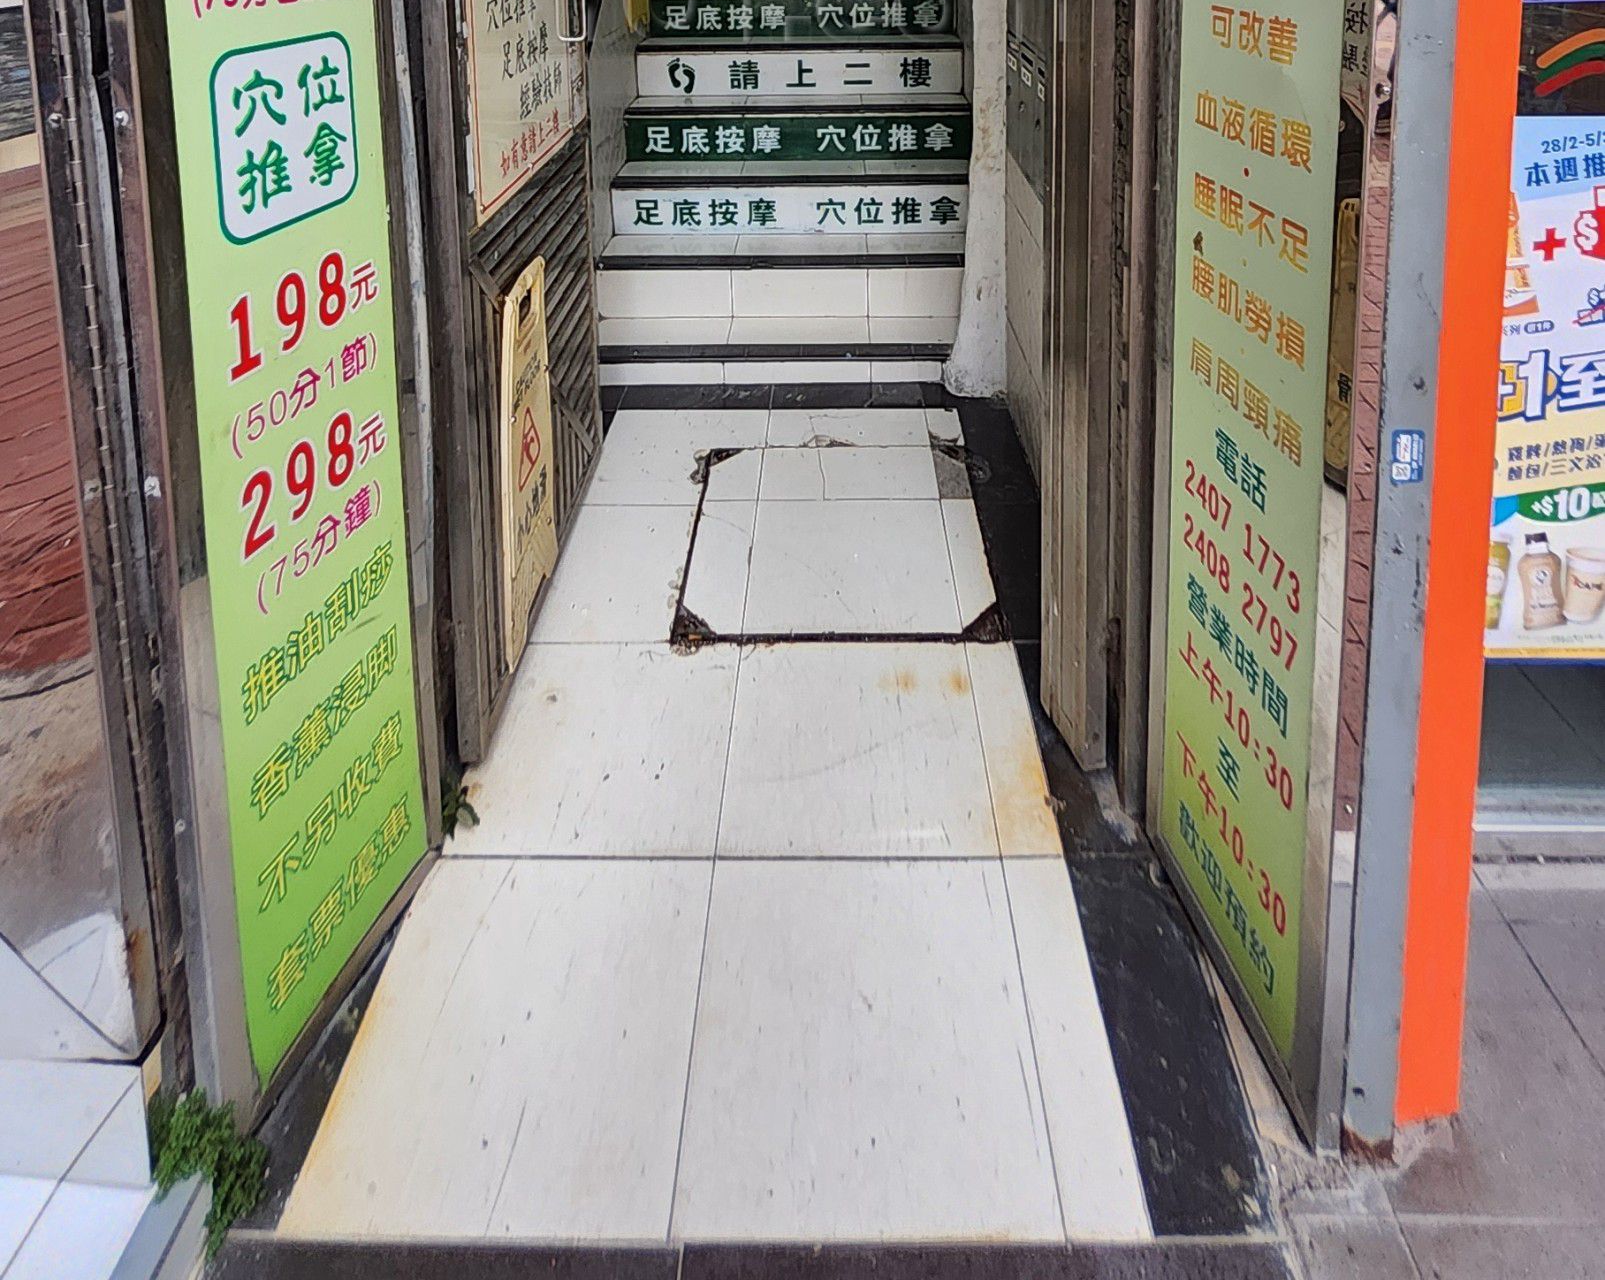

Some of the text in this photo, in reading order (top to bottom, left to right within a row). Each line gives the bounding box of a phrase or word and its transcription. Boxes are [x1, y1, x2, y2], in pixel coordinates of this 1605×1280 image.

[501, 20, 550, 82] 足底按摩
[664, 0, 942, 30] 足底按摩 穴位推拿
[1210, 5, 1299, 67] 可改善
[232, 56, 346, 139] 穴位
[727, 57, 933, 90] 請上二樓
[237, 122, 348, 214] 推拿
[645, 122, 954, 154] 足底按摩 穴位推拿
[1194, 89, 1313, 174] 血液循環
[633, 196, 961, 227] 足底按摩 穴位推拿
[1192, 171, 1310, 274] 睡眠不足
[1191, 254, 1306, 372] 腰肌勞損
[1189, 337, 1303, 468] 肩周頸痛
[1215, 427, 1266, 515] 電話
[1184, 460, 1301, 615] 2407 1773
[241, 540, 394, 726] 推油刮痧
[1182, 513, 1298, 672] 2408 2797
[1186, 572, 1289, 740] 營業時間
[1179, 631, 1293, 811] 上午10:30
[258, 710, 402, 914] 不另收費
[1216, 736, 1241, 803] 至
[267, 793, 411, 1013] 套票優惠
